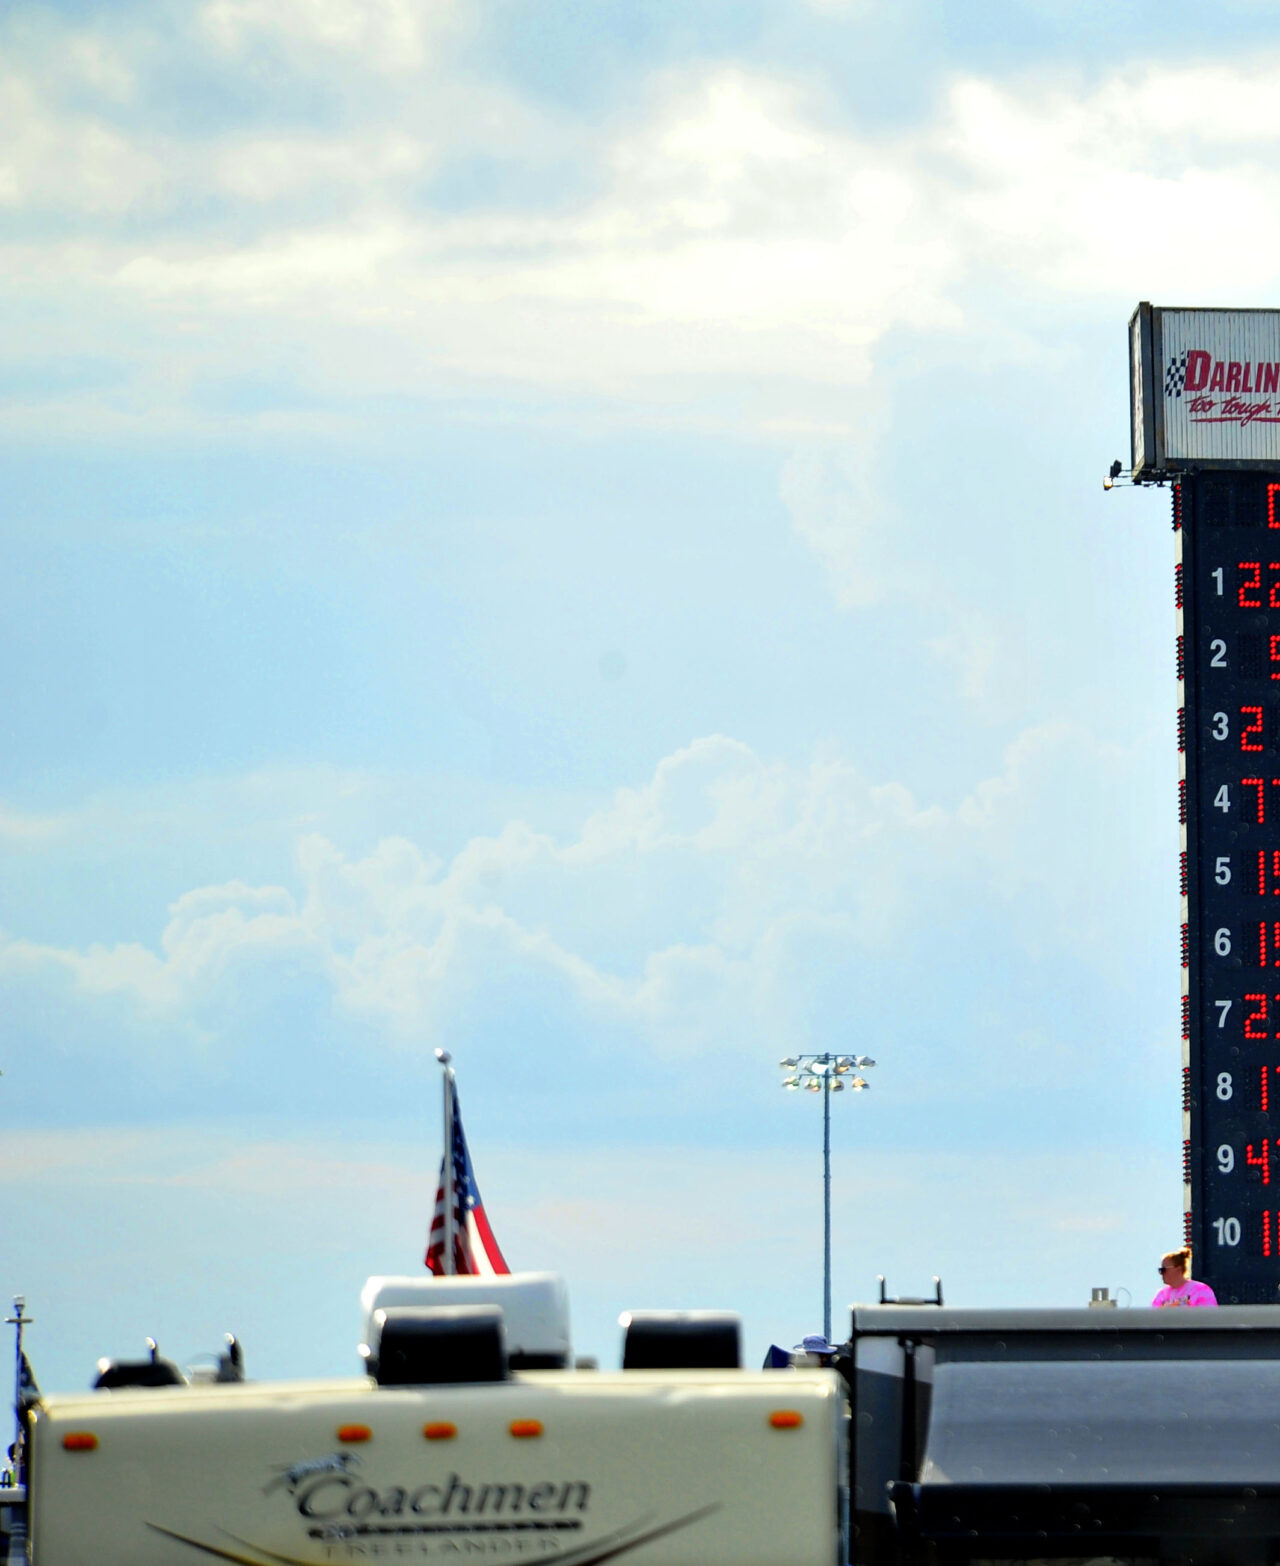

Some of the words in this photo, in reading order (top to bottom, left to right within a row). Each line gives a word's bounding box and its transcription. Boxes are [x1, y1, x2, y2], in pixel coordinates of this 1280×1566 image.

[1211, 567, 1223, 596] 1
[1210, 638, 1227, 668] 2
[1211, 711, 1229, 741] 3
[1213, 784, 1231, 813] 4
[1214, 856, 1232, 885] 5
[1214, 927, 1232, 957] 6
[1214, 1000, 1232, 1028] 7
[1216, 1072, 1233, 1101] 8
[1216, 1144, 1235, 1173] 9
[1212, 1217, 1241, 1246] 10
[297, 1472, 592, 1519] Coachmen
